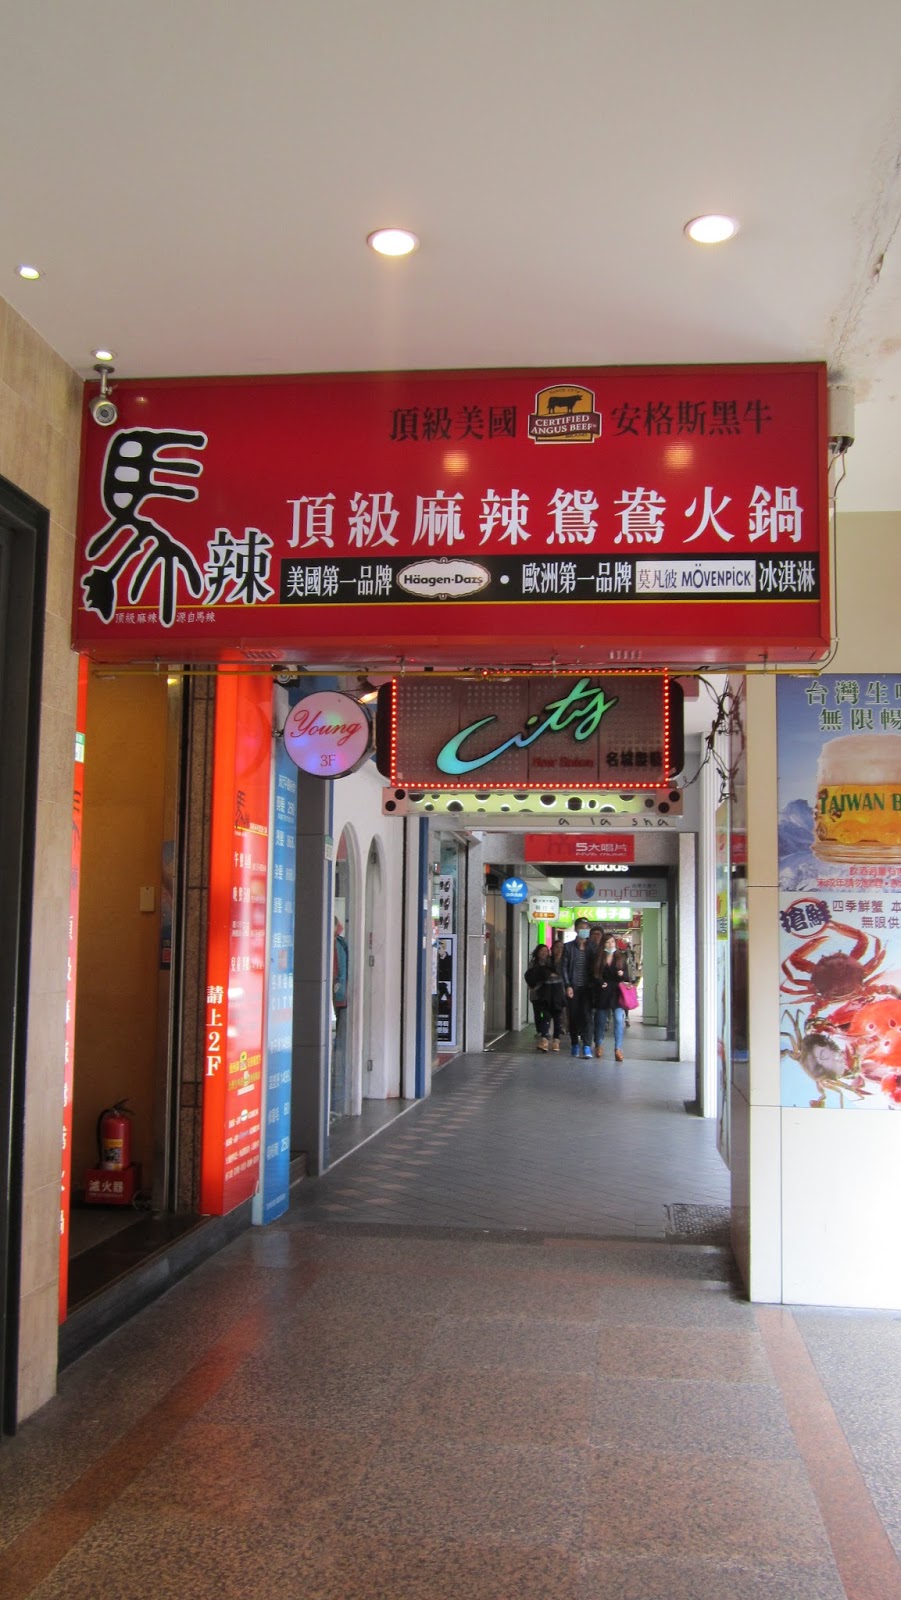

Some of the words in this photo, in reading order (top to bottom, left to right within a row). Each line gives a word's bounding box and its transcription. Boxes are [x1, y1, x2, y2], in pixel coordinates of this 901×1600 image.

[389, 405, 517, 441] 頂級美國
[611, 400, 773, 437] 安格斯黑牛
[530, 425, 568, 435] ANGUS
[535, 414, 590, 427] CERTIFIED
[286, 485, 804, 548] 頂級麻辣鴛鴦火鍋
[286, 564, 393, 597] 美國第一品牌
[521, 561, 632, 594] 歐洲第一品牌
[638, 569, 677, 589] 莫凡彼
[758, 560, 816, 593] 冰淇淋
[115, 612, 158, 624] 頂級麻辣
[290, 709, 361, 746] Young
[436, 678, 619, 775] City
[320, 754, 336, 767] 3F
[819, 792, 885, 815] TAIWAN
[575, 842, 628, 852] 5大唱片
[598, 886, 658, 900] myfone
